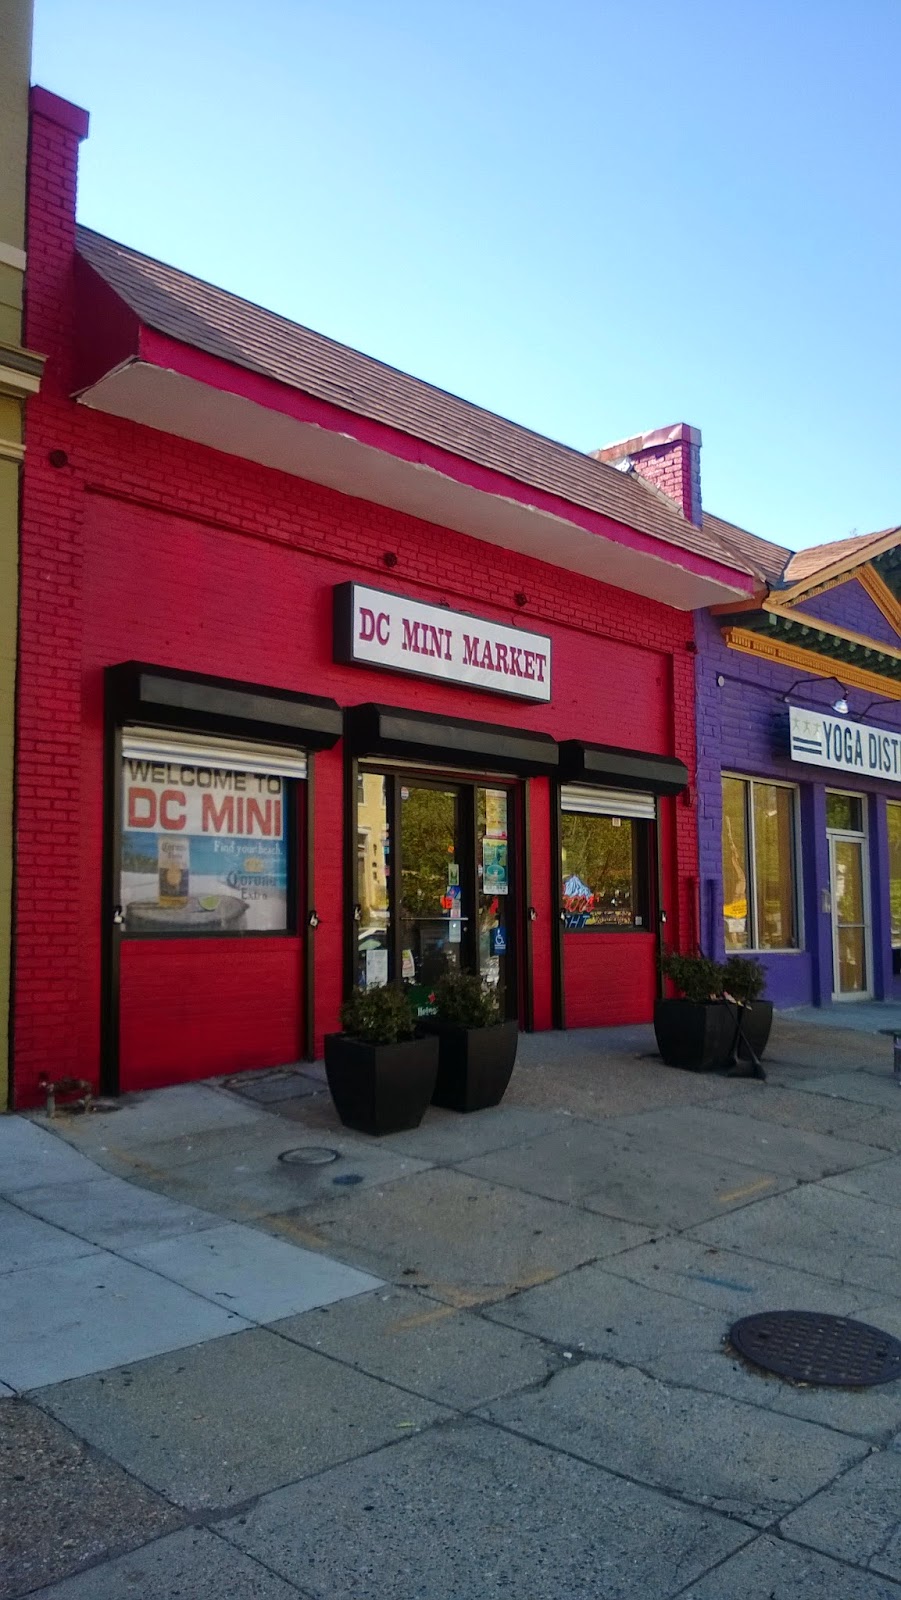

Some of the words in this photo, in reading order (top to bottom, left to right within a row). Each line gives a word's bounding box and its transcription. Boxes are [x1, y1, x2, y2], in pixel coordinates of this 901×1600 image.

[359, 607, 391, 646] DC
[401, 618, 452, 661] MINI
[462, 634, 547, 683] MARKET
[823, 720, 864, 767] YOGA
[868, 732, 901, 774] DIST
[127, 758, 247, 792] WELCOME
[253, 773, 282, 795] TO
[127, 786, 187, 831] DC
[202, 793, 282, 837] MINI
[213, 840, 235, 853] Find
[226, 869, 277, 891] Corona
